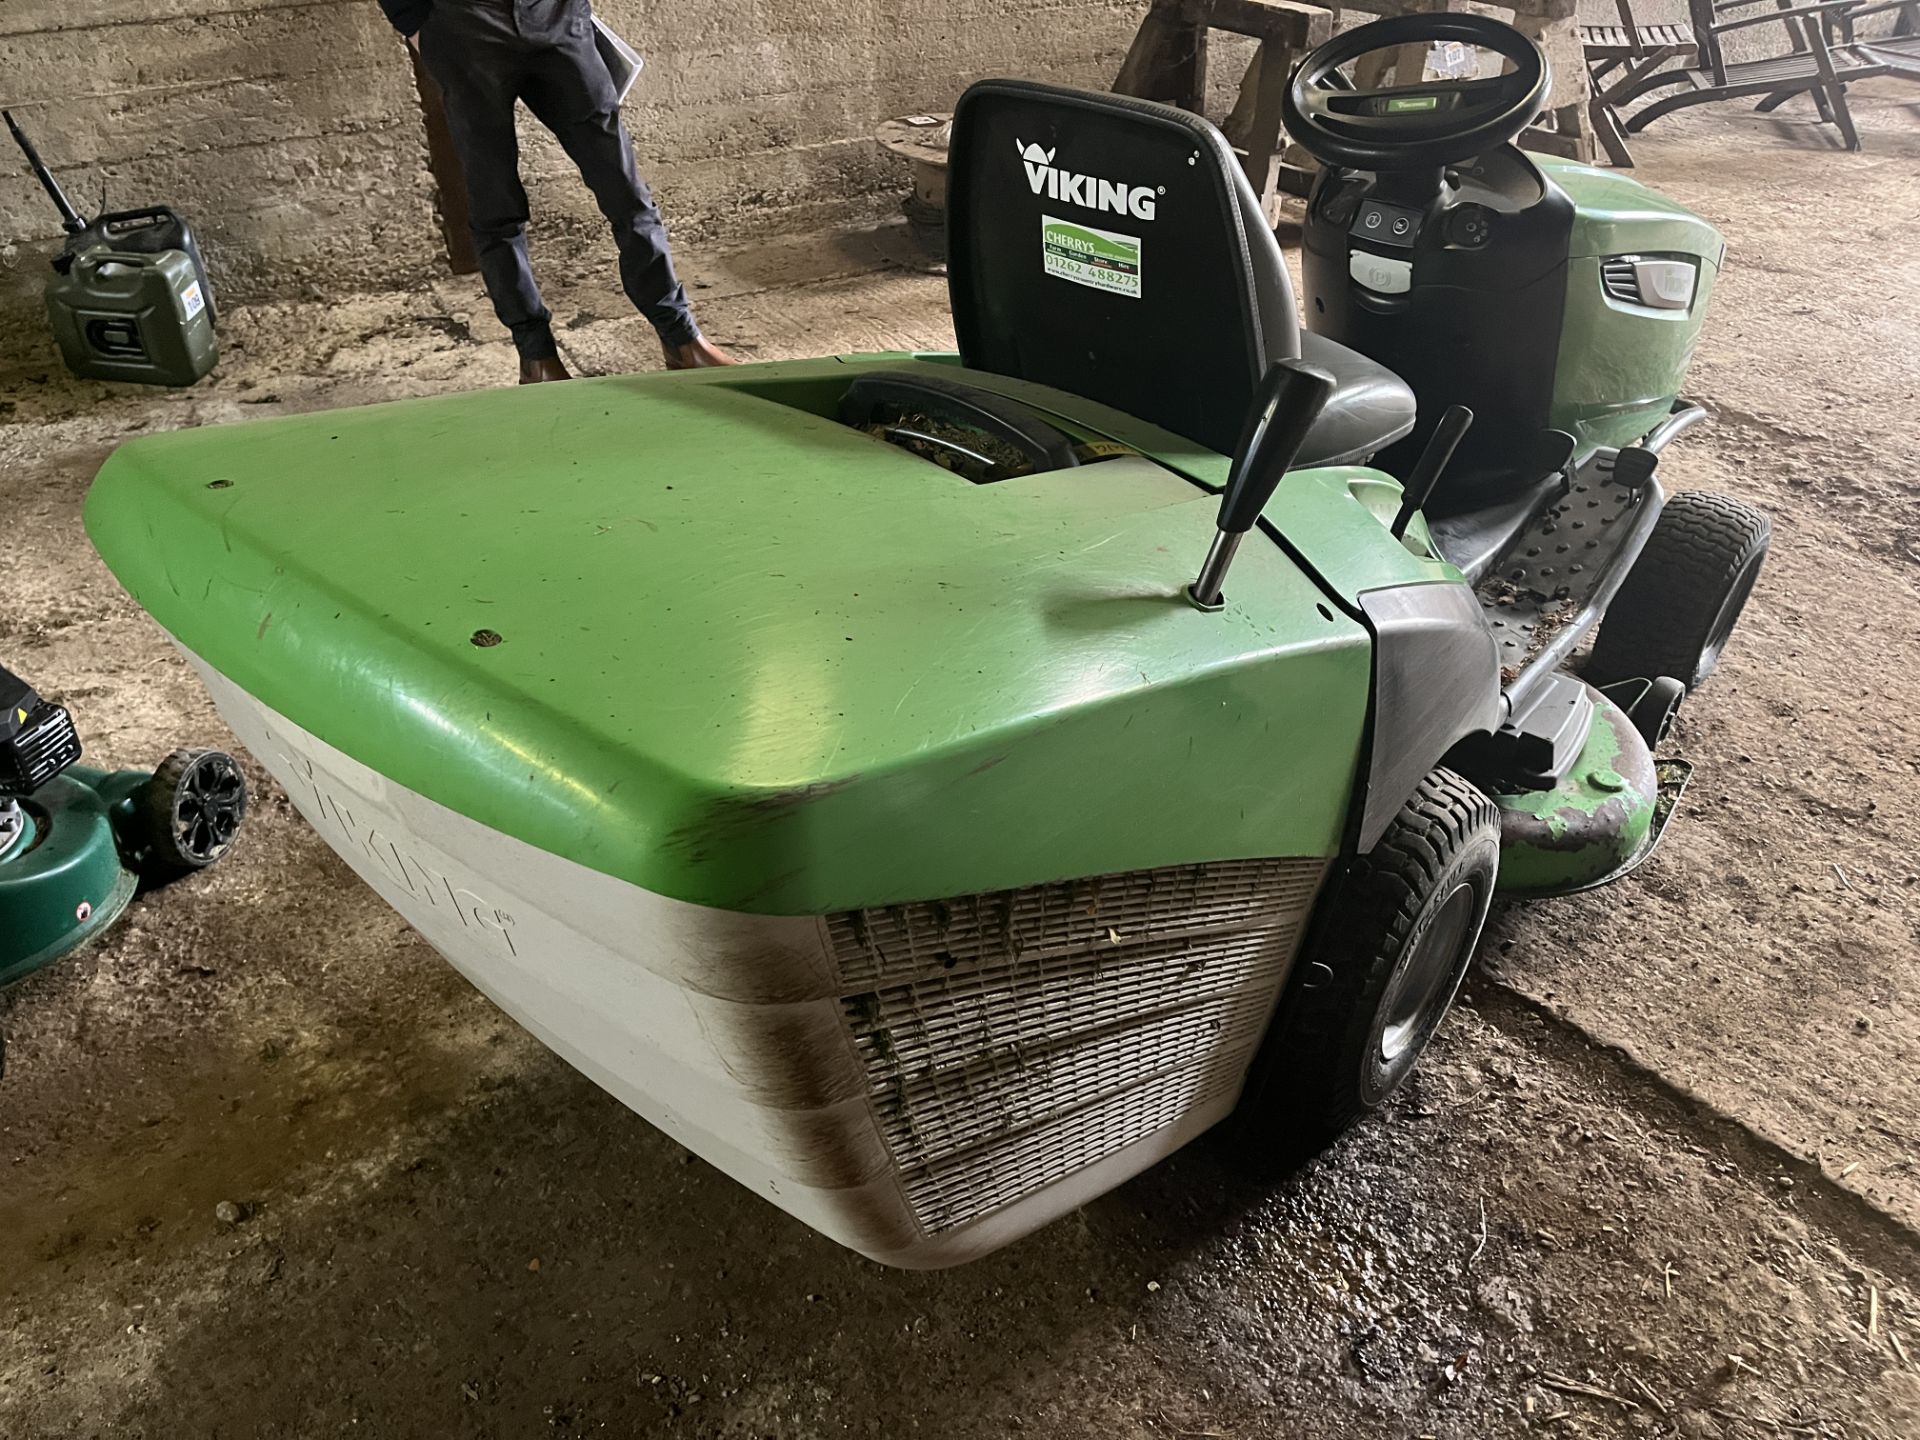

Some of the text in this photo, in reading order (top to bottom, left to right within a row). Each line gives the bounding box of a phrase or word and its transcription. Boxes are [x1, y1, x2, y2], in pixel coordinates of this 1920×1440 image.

[1023, 160, 1156, 221] VIKING
[1046, 230, 1096, 254] CHERRYS
[1045, 254, 1083, 275] 01262
[1088, 267, 1139, 288] 488275
